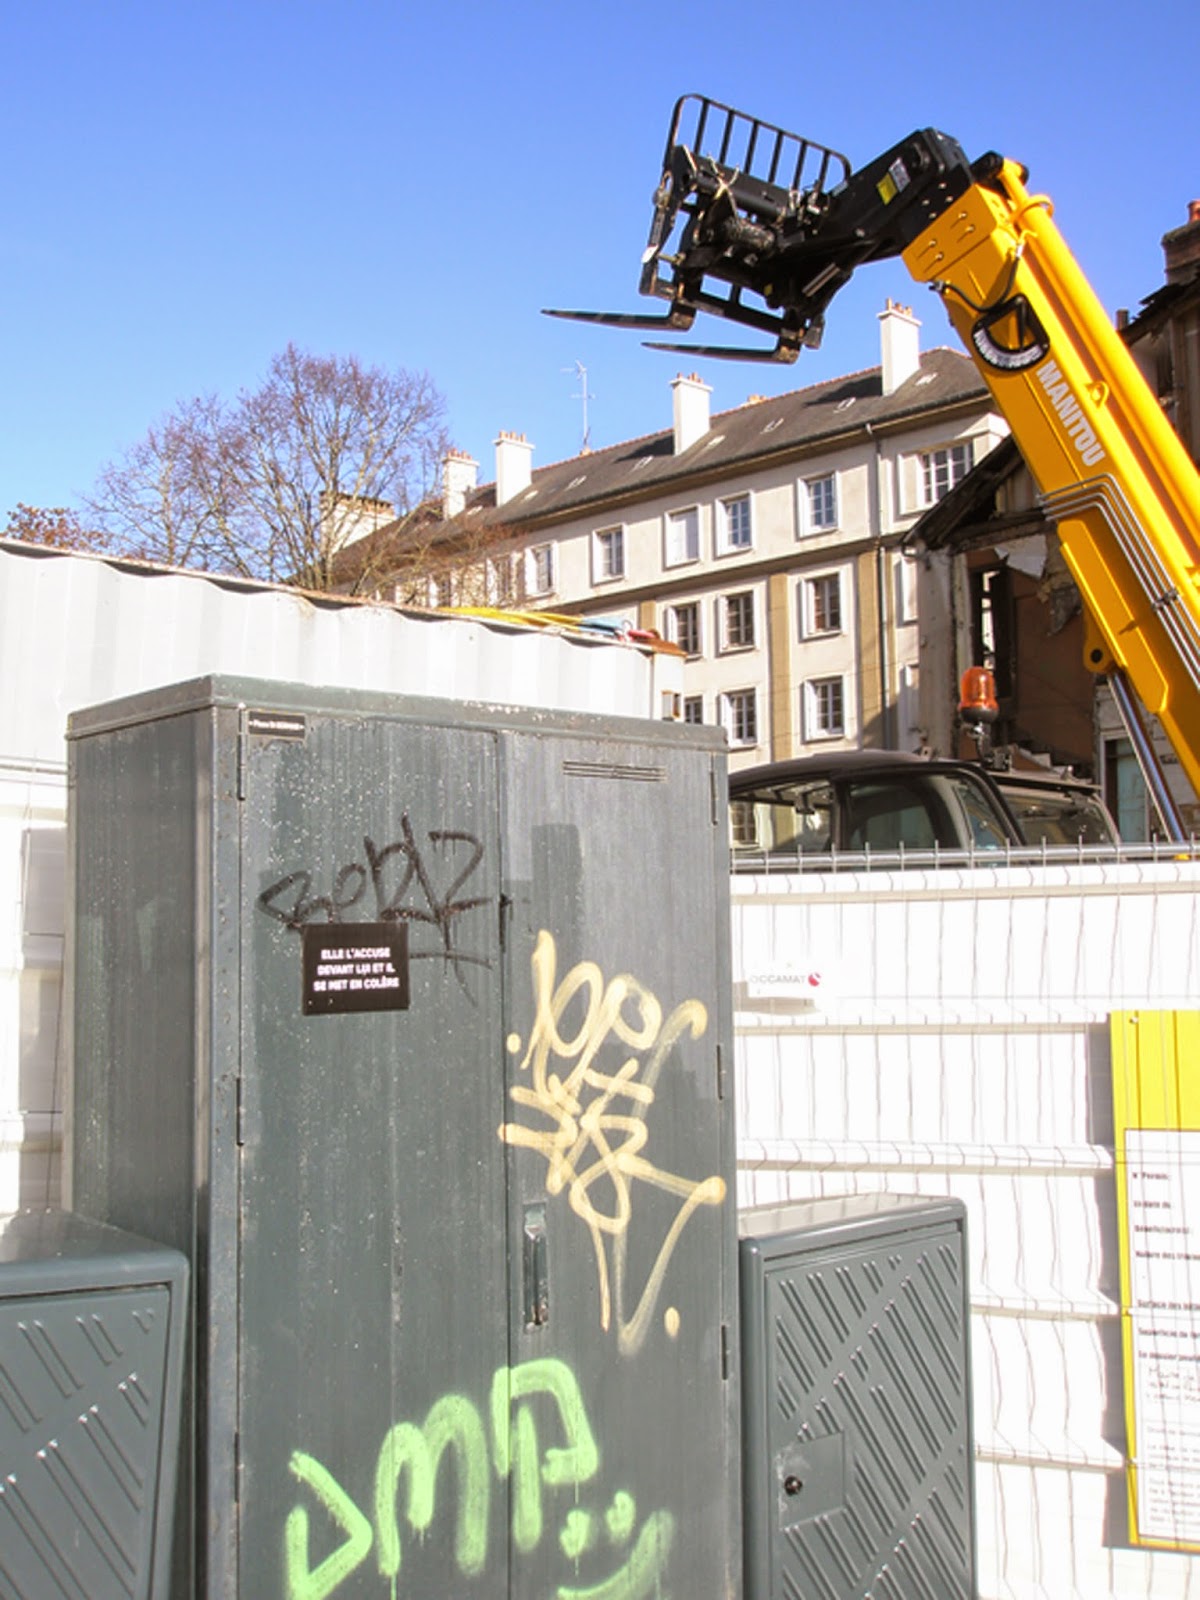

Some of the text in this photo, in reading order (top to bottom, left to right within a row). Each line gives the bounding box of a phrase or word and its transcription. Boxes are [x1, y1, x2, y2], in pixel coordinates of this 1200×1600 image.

[1036, 360, 1106, 467] MANITOU
[321, 947, 390, 959] ELLE L'ACCUSE
[317, 964, 354, 975] DEVANT
[372, 963, 384, 973] ET
[313, 981, 326, 991] SE
[328, 980, 348, 990] MET
[350, 979, 362, 990] EN
[750, 974, 806, 984] OCCAMAT
